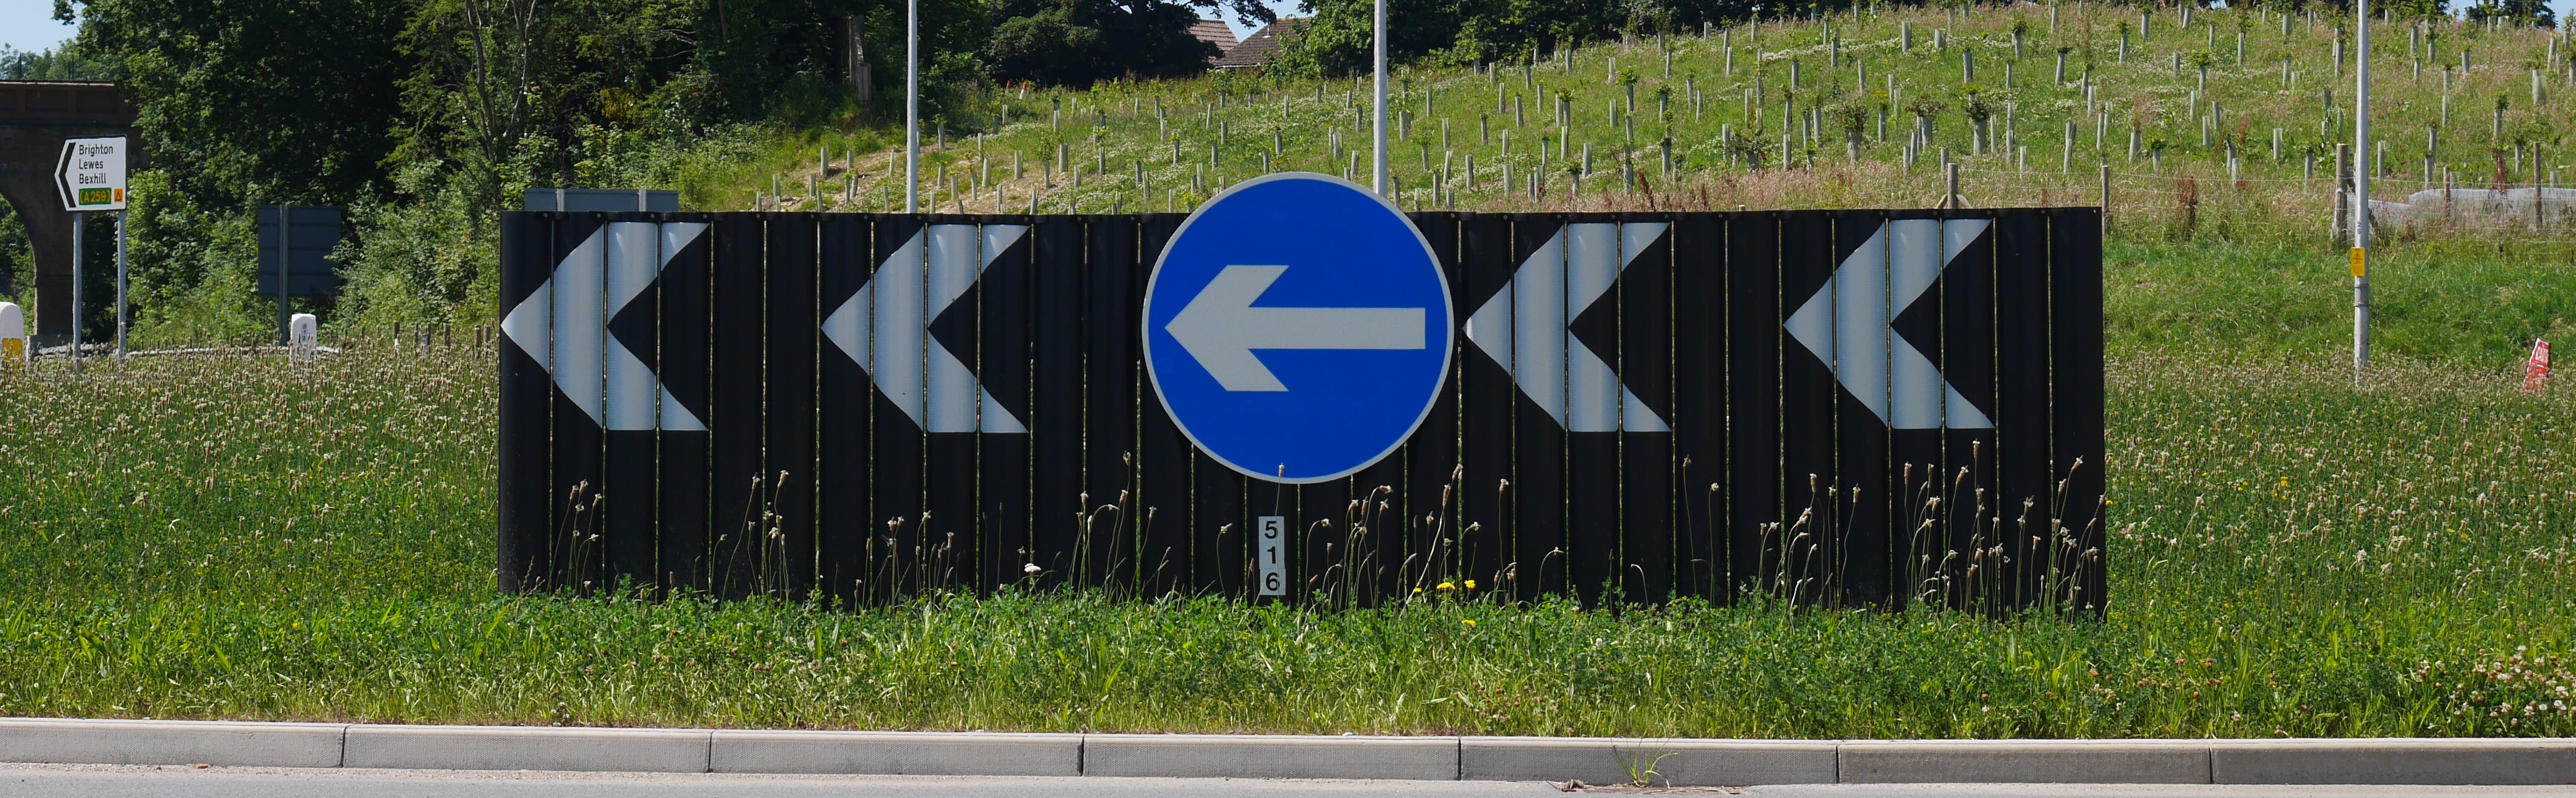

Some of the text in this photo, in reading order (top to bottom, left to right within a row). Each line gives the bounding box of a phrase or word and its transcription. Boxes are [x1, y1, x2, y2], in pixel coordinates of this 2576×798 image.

[79, 144, 113, 157] Brighton
[79, 158, 104, 170] Lewes
[79, 173, 107, 185] Bexhill
